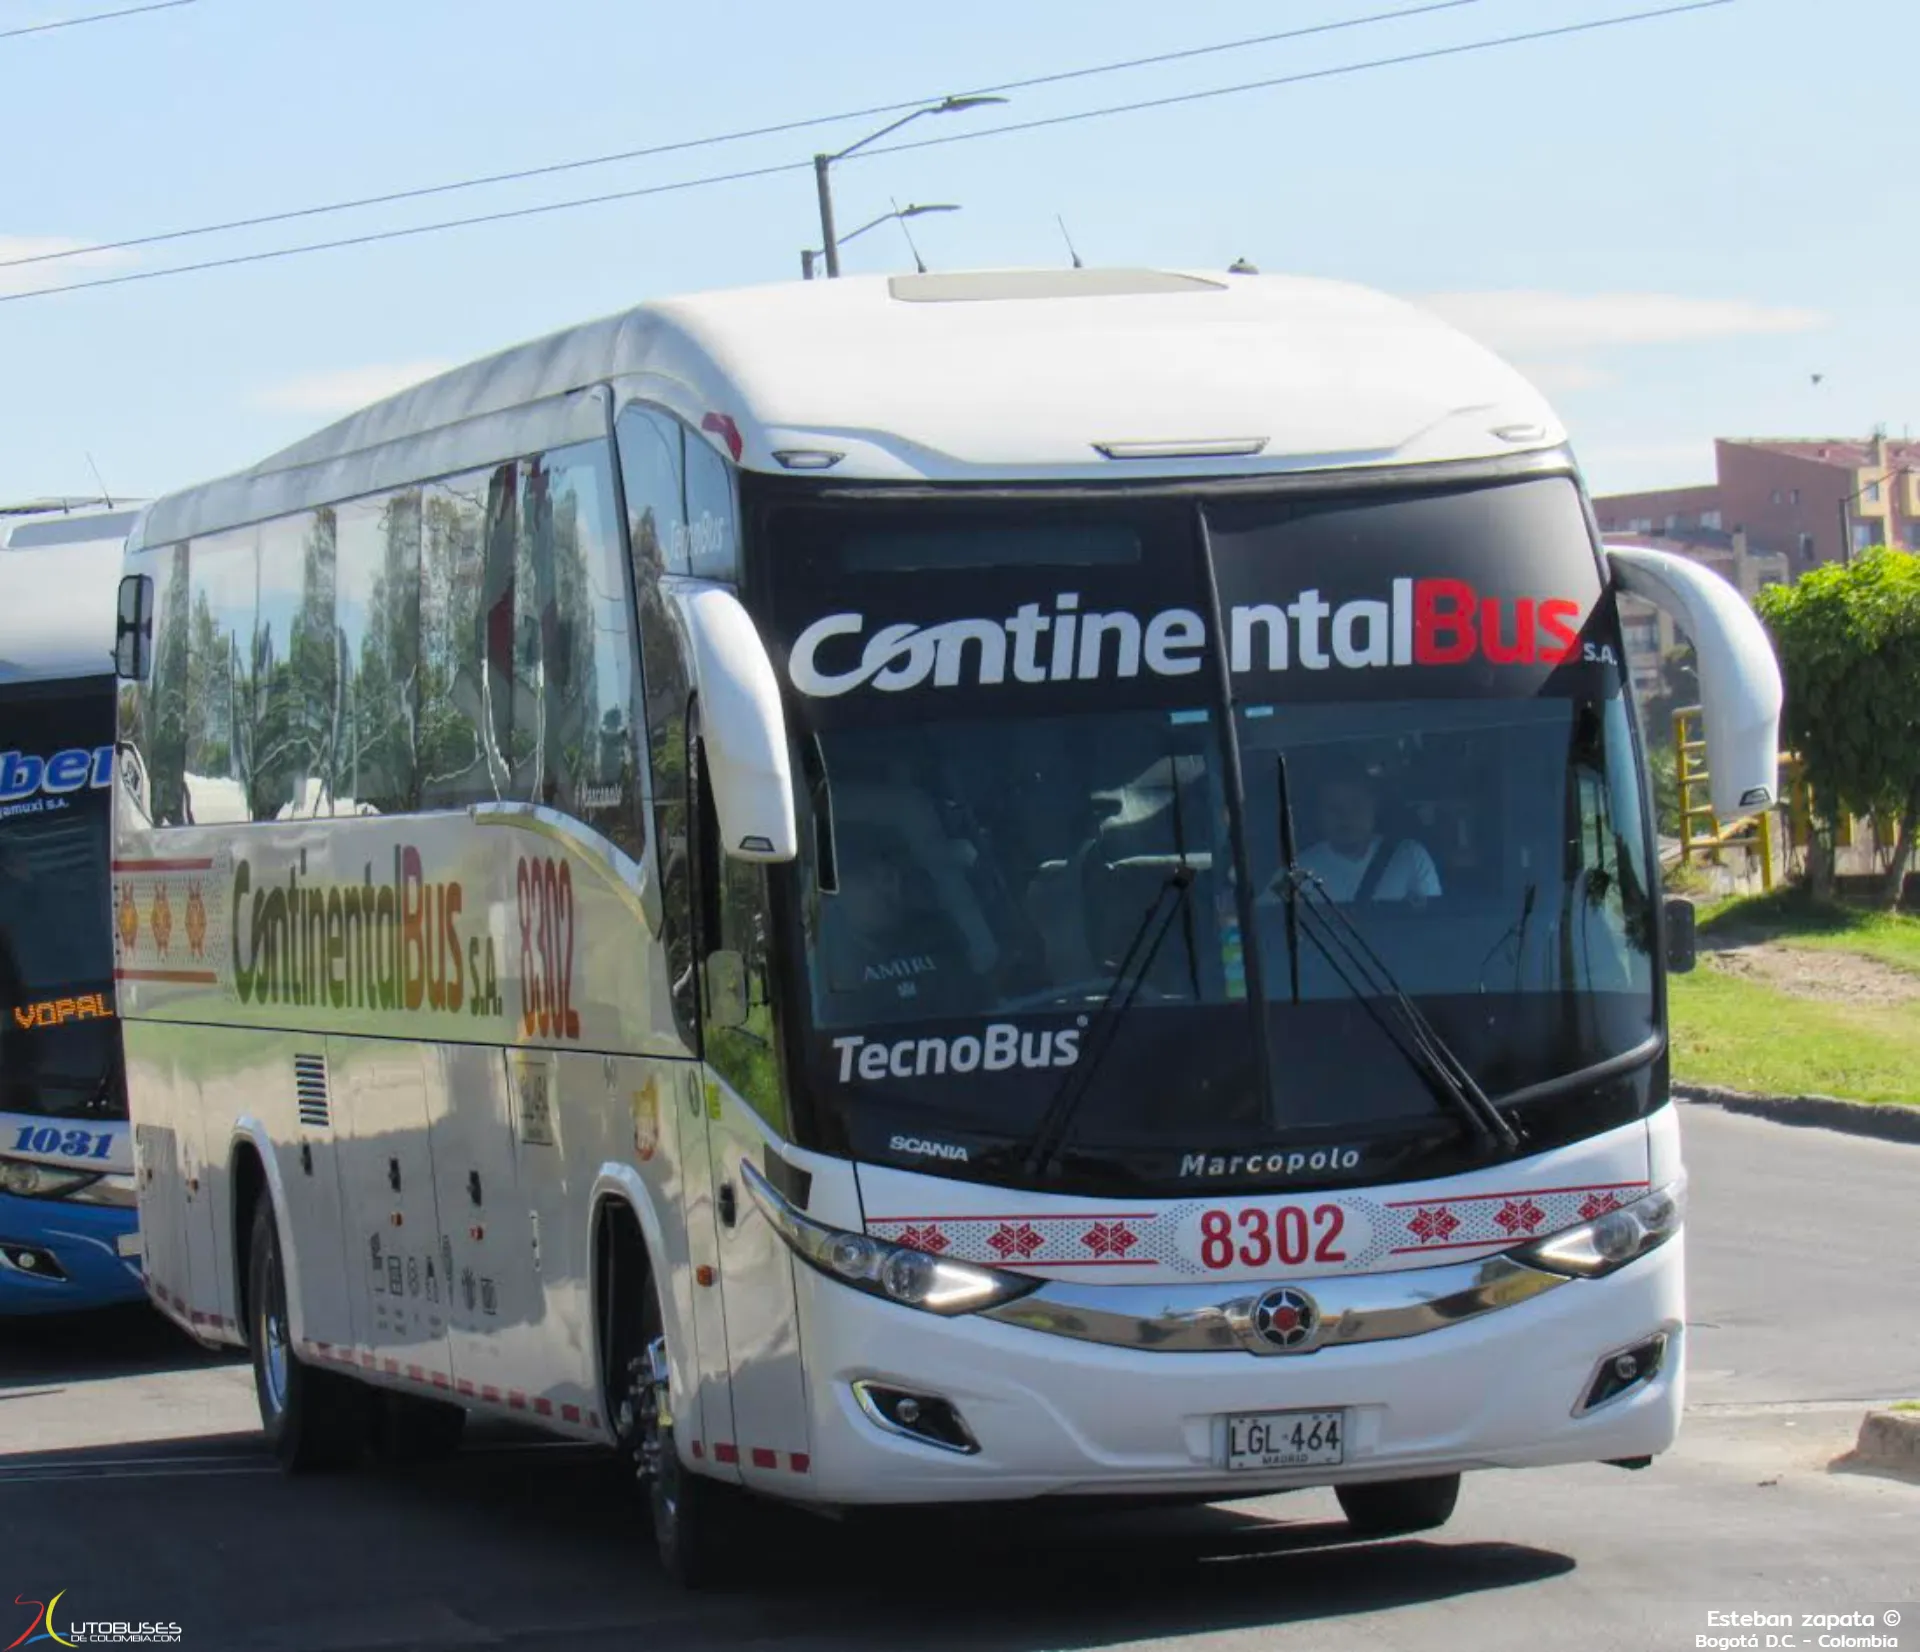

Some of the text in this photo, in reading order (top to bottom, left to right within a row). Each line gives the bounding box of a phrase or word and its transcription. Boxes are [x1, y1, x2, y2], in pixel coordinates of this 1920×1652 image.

[1583, 643, 1618, 666] S.A.
[232, 844, 579, 1039] ContinentalBus S.A. 8302
[10, 1126, 114, 1160] 1031
[889, 1136, 969, 1162] SCANIA
[1179, 1147, 1360, 1178] Marcopolo
[1200, 1203, 1346, 1269] 8302
